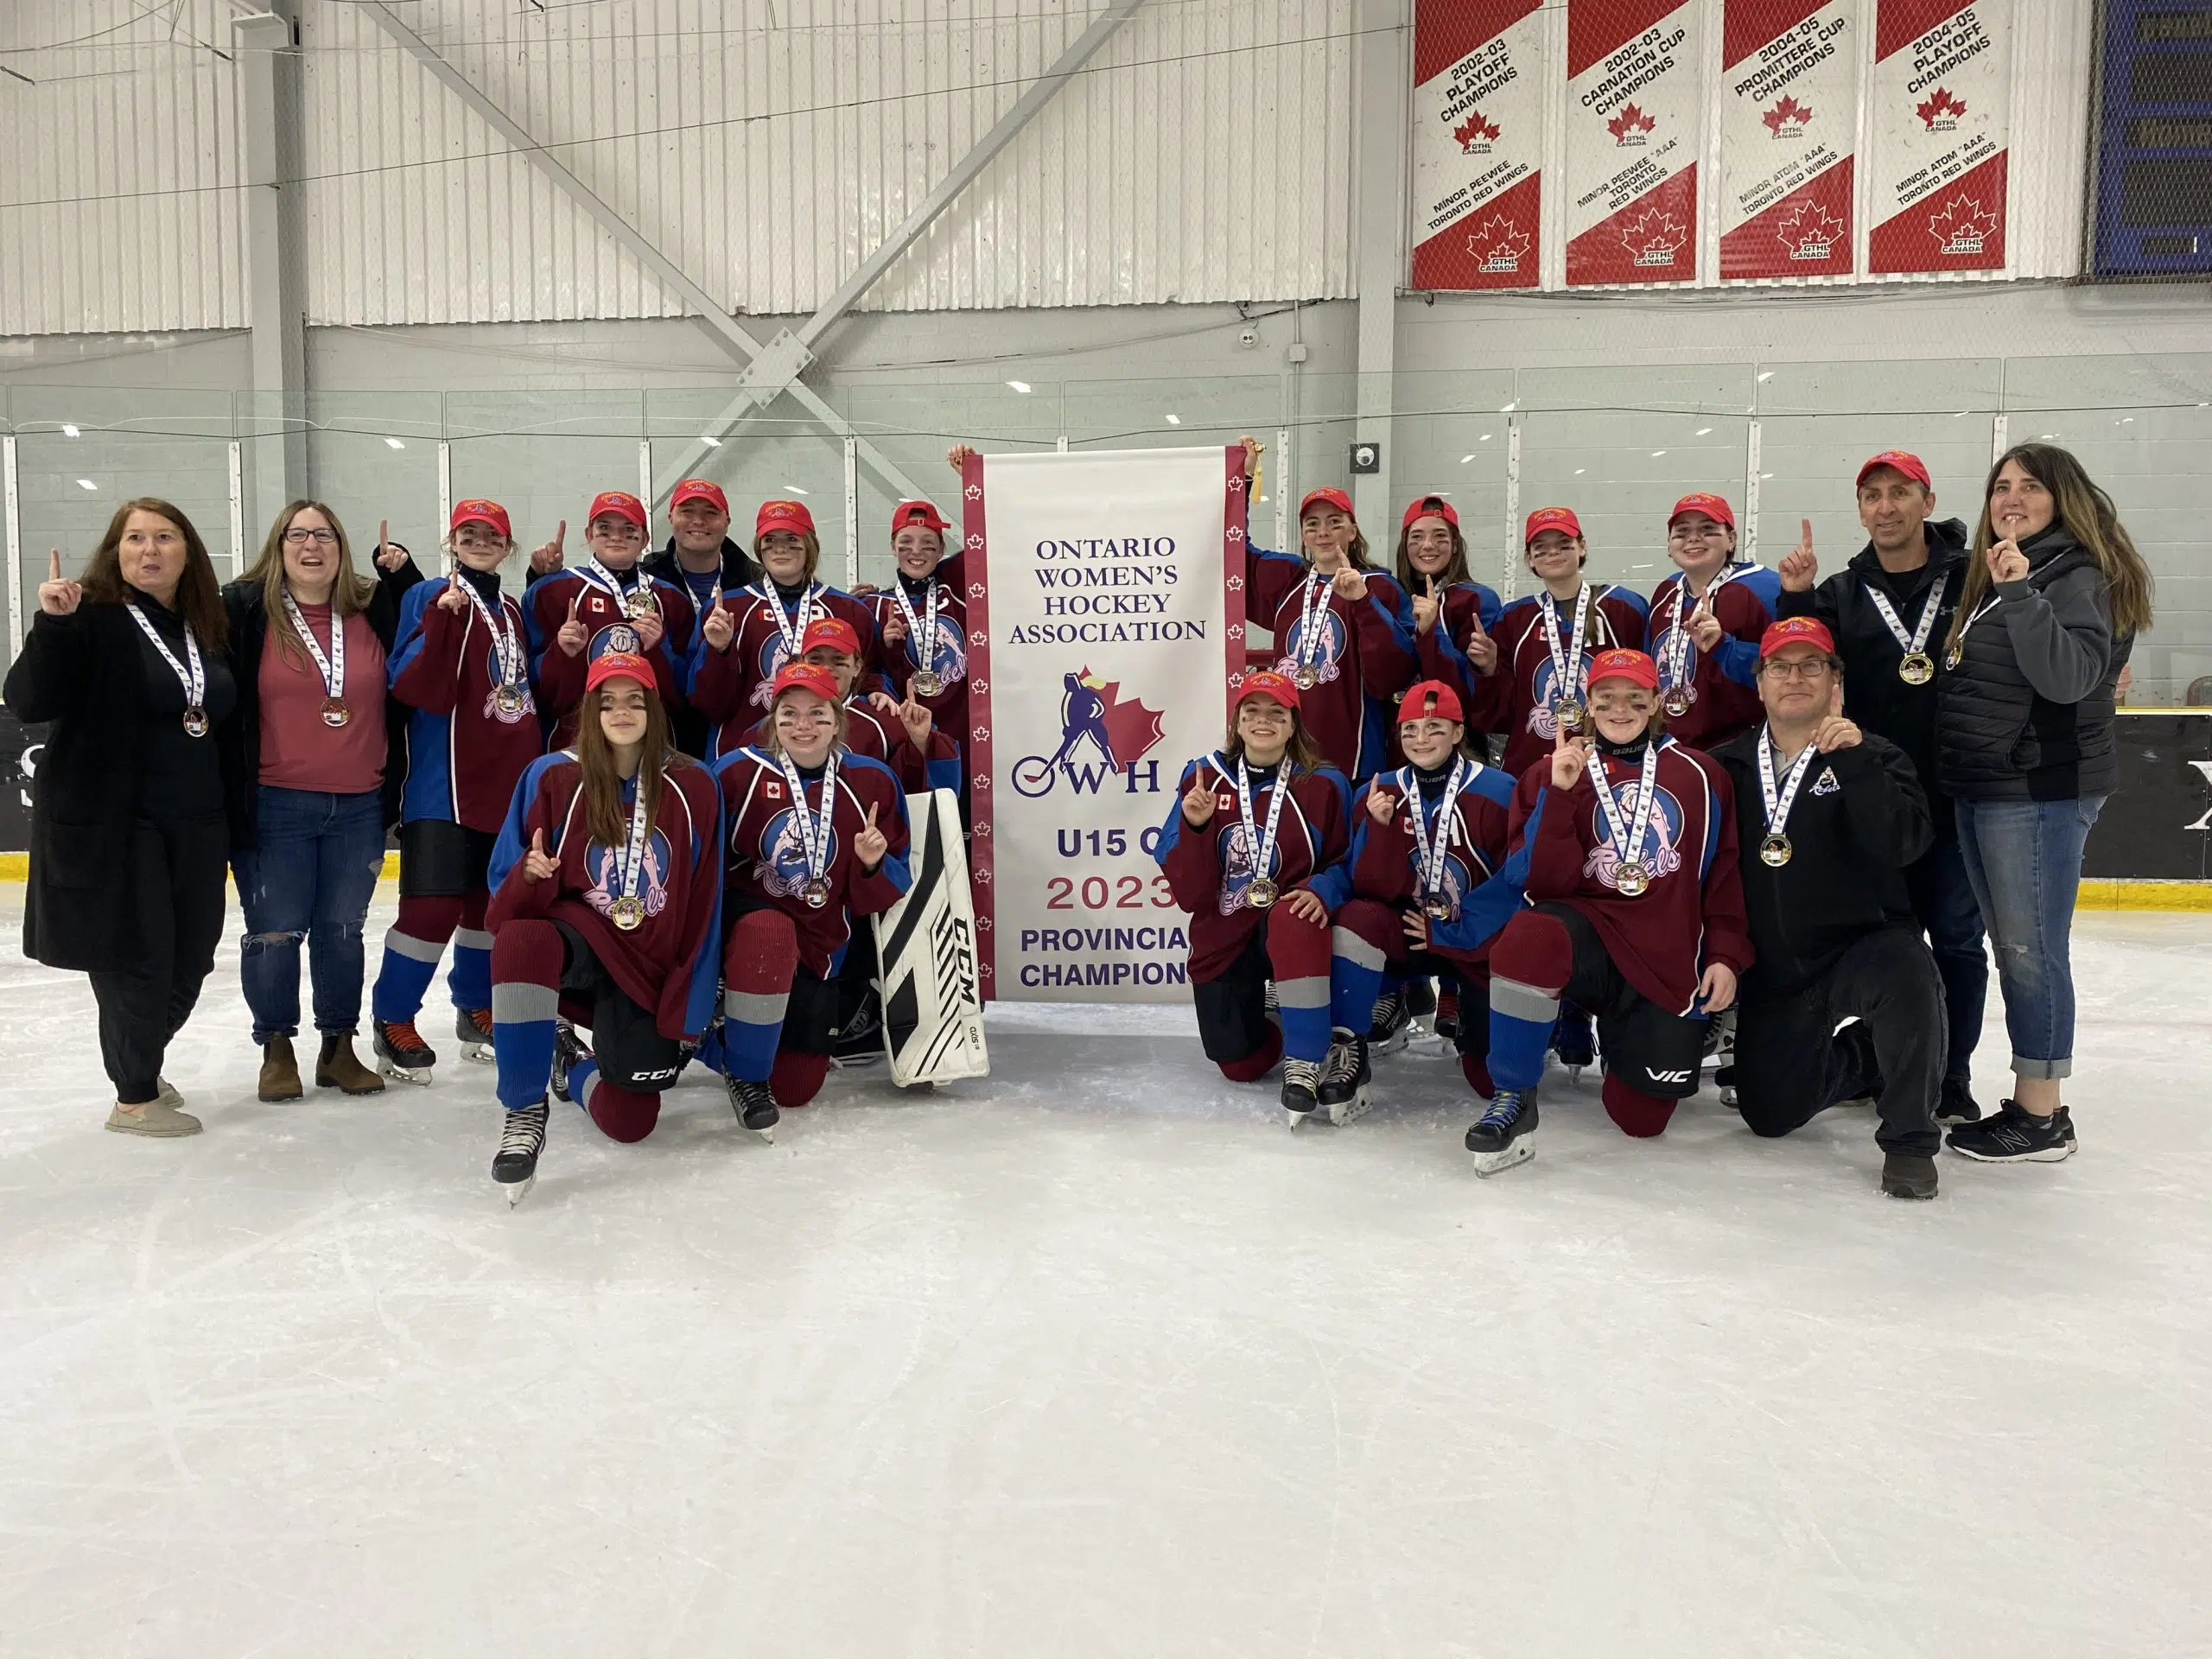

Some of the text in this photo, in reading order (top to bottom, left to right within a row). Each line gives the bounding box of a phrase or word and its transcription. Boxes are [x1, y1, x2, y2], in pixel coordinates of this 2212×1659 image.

[1605, 29, 1662, 73] 2002-03
[1758, 16, 1820, 62] 2004-05
[1912, 9, 1976, 54] 2004-05
[1913, 22, 1983, 72] PLAYOFF
[1446, 53, 1510, 101] PLAYOFF
[1451, 39, 1506, 80] 2002-03
[1580, 29, 1686, 107] CARNATION CUP
[1734, 17, 1846, 98] PROMITTERE CUP
[1752, 43, 1836, 103] CHAMPIONS
[1907, 35, 1991, 94] CHAMPIONS
[1440, 67, 1518, 123] CHAMPIONS
[1595, 55, 1675, 116] CHAMPIONS
[1433, 161, 1510, 213] MINOR PEEWEE
[1577, 182, 1611, 208] MINOR
[1611, 157, 1650, 188] PEEWEE
[1608, 168, 1669, 210] RED WINGS
[1609, 164, 1657, 197] TORONTO
[1738, 177, 1772, 204] MINOR
[1773, 160, 1800, 182] ATOM
[1743, 151, 1838, 215] TORONTO RED WINGS
[1896, 167, 1929, 193] MINOR
[1930, 150, 1958, 174] ATOM
[1897, 142, 1997, 206] TORONTO RED WINGS
[1427, 163, 1529, 231] TORONTO RED WINGS
[1942, 245, 1981, 254] CANADA
[1036, 537, 1176, 560] ONTARIO
[1034, 565, 1178, 588] WOMEN'S
[812, 620, 843, 632] CHAMPIONS
[1044, 594, 1171, 615] HOCKEY
[1008, 620, 1206, 644] ASSOCIATION
[1601, 650, 1642, 662] CHAMPIONS
[1058, 828, 1127, 857] U15
[1046, 875, 1176, 909] 2023
[954, 917, 976, 1005] CCM
[1021, 927, 1188, 951] PROVINCIA
[1020, 963, 1186, 987] CHAMPION
[632, 1065, 678, 1082] CCM
[1645, 1066, 1693, 1083] VIC
